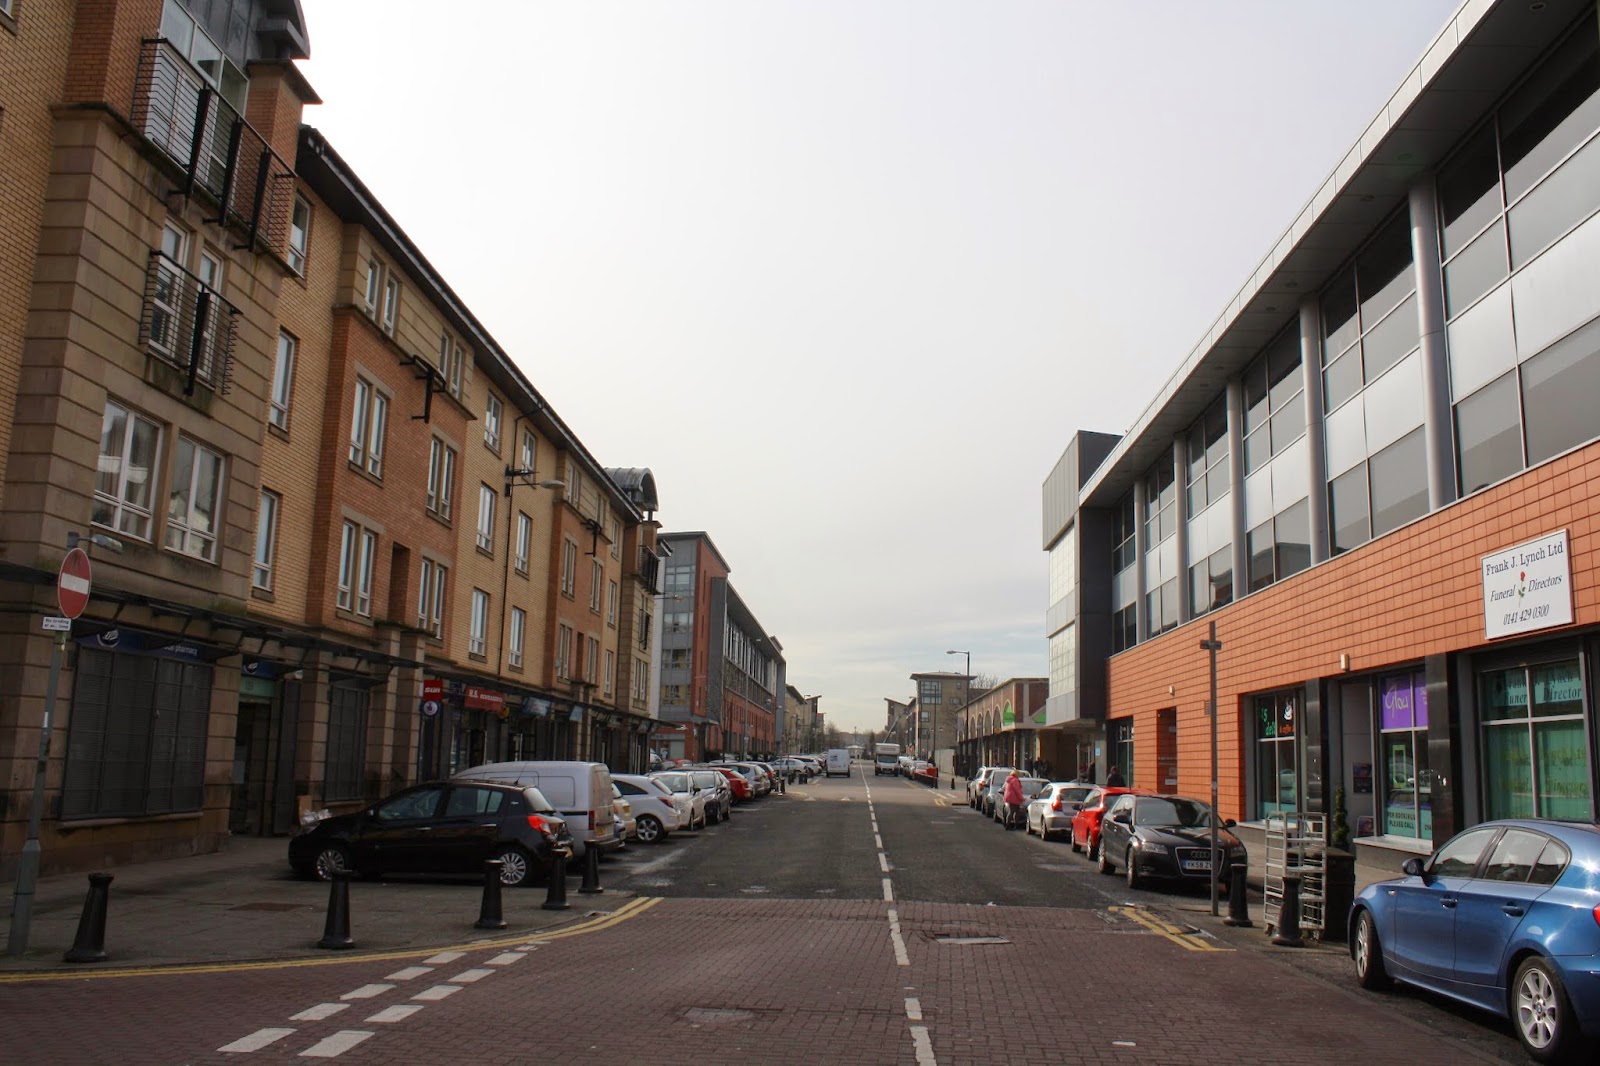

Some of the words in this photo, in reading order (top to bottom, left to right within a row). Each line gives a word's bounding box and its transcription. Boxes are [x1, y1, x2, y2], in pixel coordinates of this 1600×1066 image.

[1486, 560, 1509, 576] Frank
[1511, 556, 1518, 568] J.
[1520, 548, 1545, 567] Lynch
[1547, 541, 1564, 557] Ltd
[1490, 585, 1516, 602] Funeral
[1528, 574, 1562, 592] Directors
[1503, 610, 1518, 625] 0141
[1520, 608, 1532, 622] 429
[1532, 604, 1550, 619] 0300
